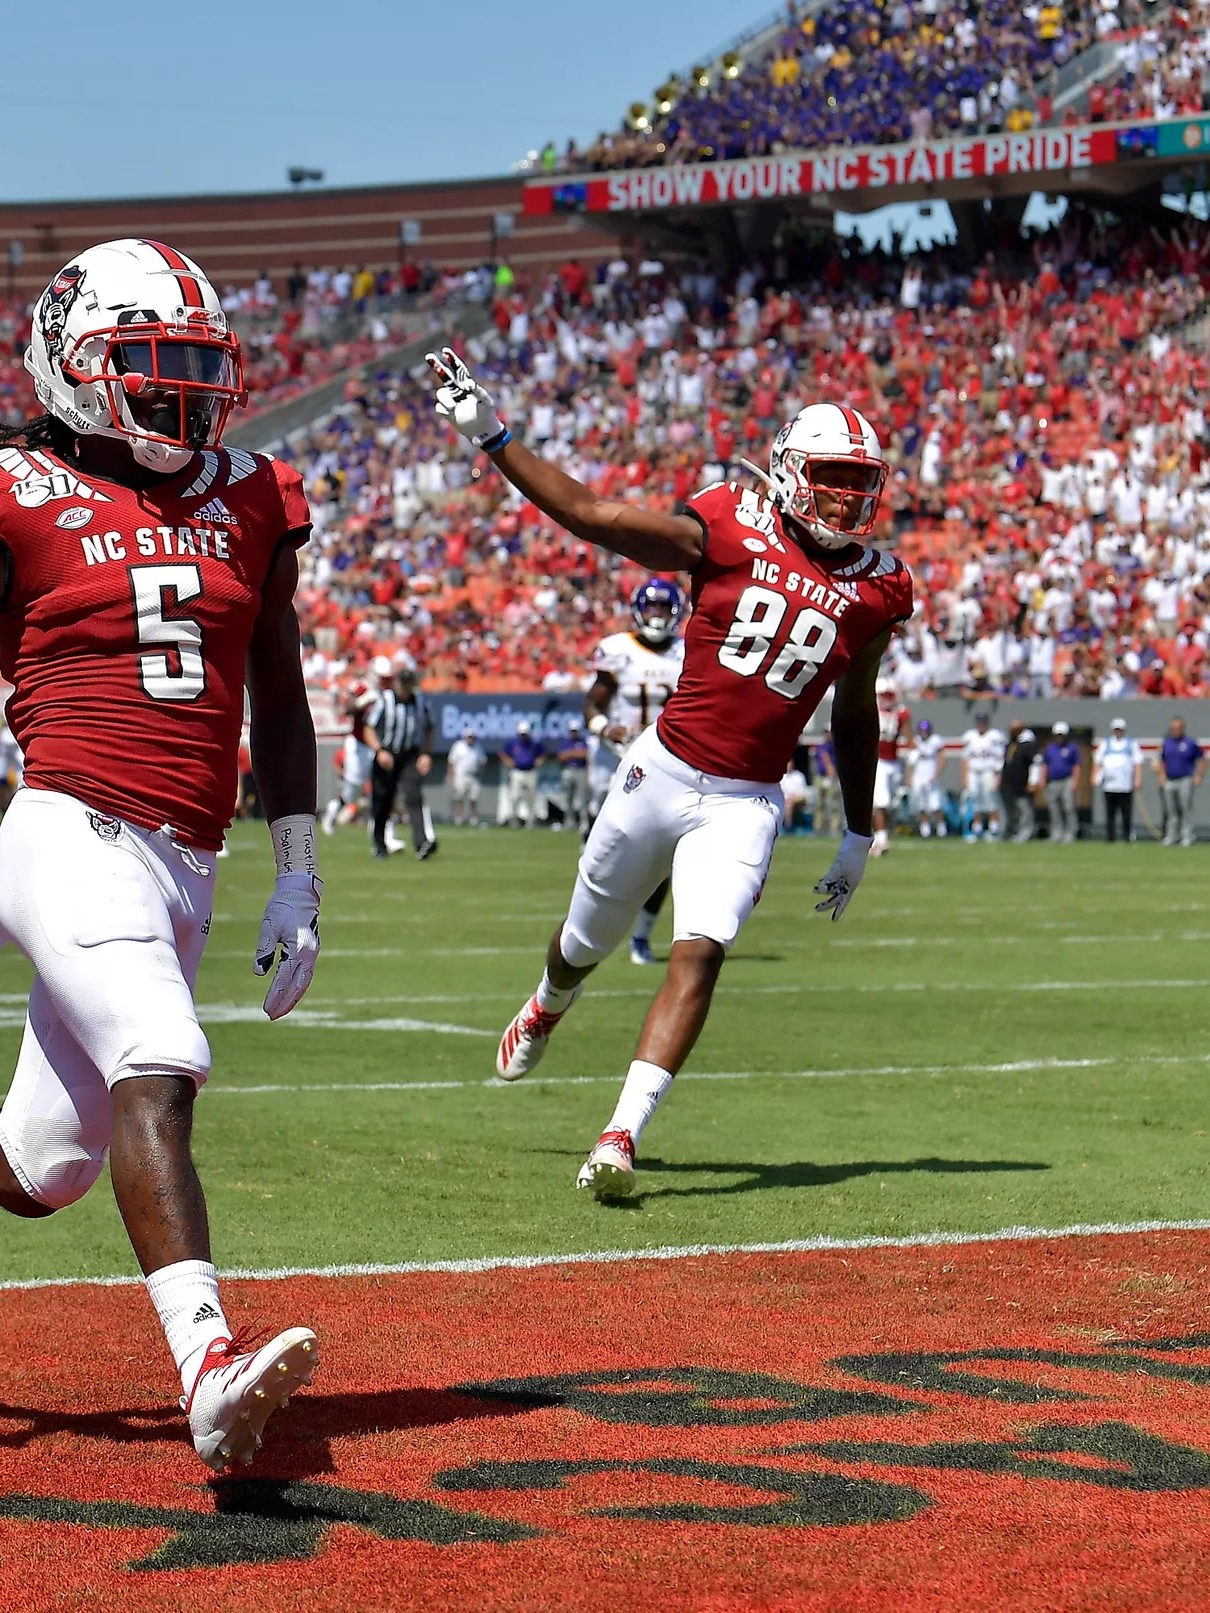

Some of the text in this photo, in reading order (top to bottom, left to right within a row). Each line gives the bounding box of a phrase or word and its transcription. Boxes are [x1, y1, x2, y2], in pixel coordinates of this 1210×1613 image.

[608, 129, 1092, 211] SHOW YOUR NC STATE PRIDE
[65, 406, 91, 430] schutt
[14, 473, 71, 498] 150
[62, 508, 88, 523] ACC
[193, 511, 238, 525] adidas
[80, 526, 230, 566] NC STATE
[751, 557, 851, 618] NC STATE
[128, 562, 208, 702] 5
[717, 585, 838, 700] 88
[280, 827, 292, 860] Psalm
[303, 825, 314, 860] Trust
